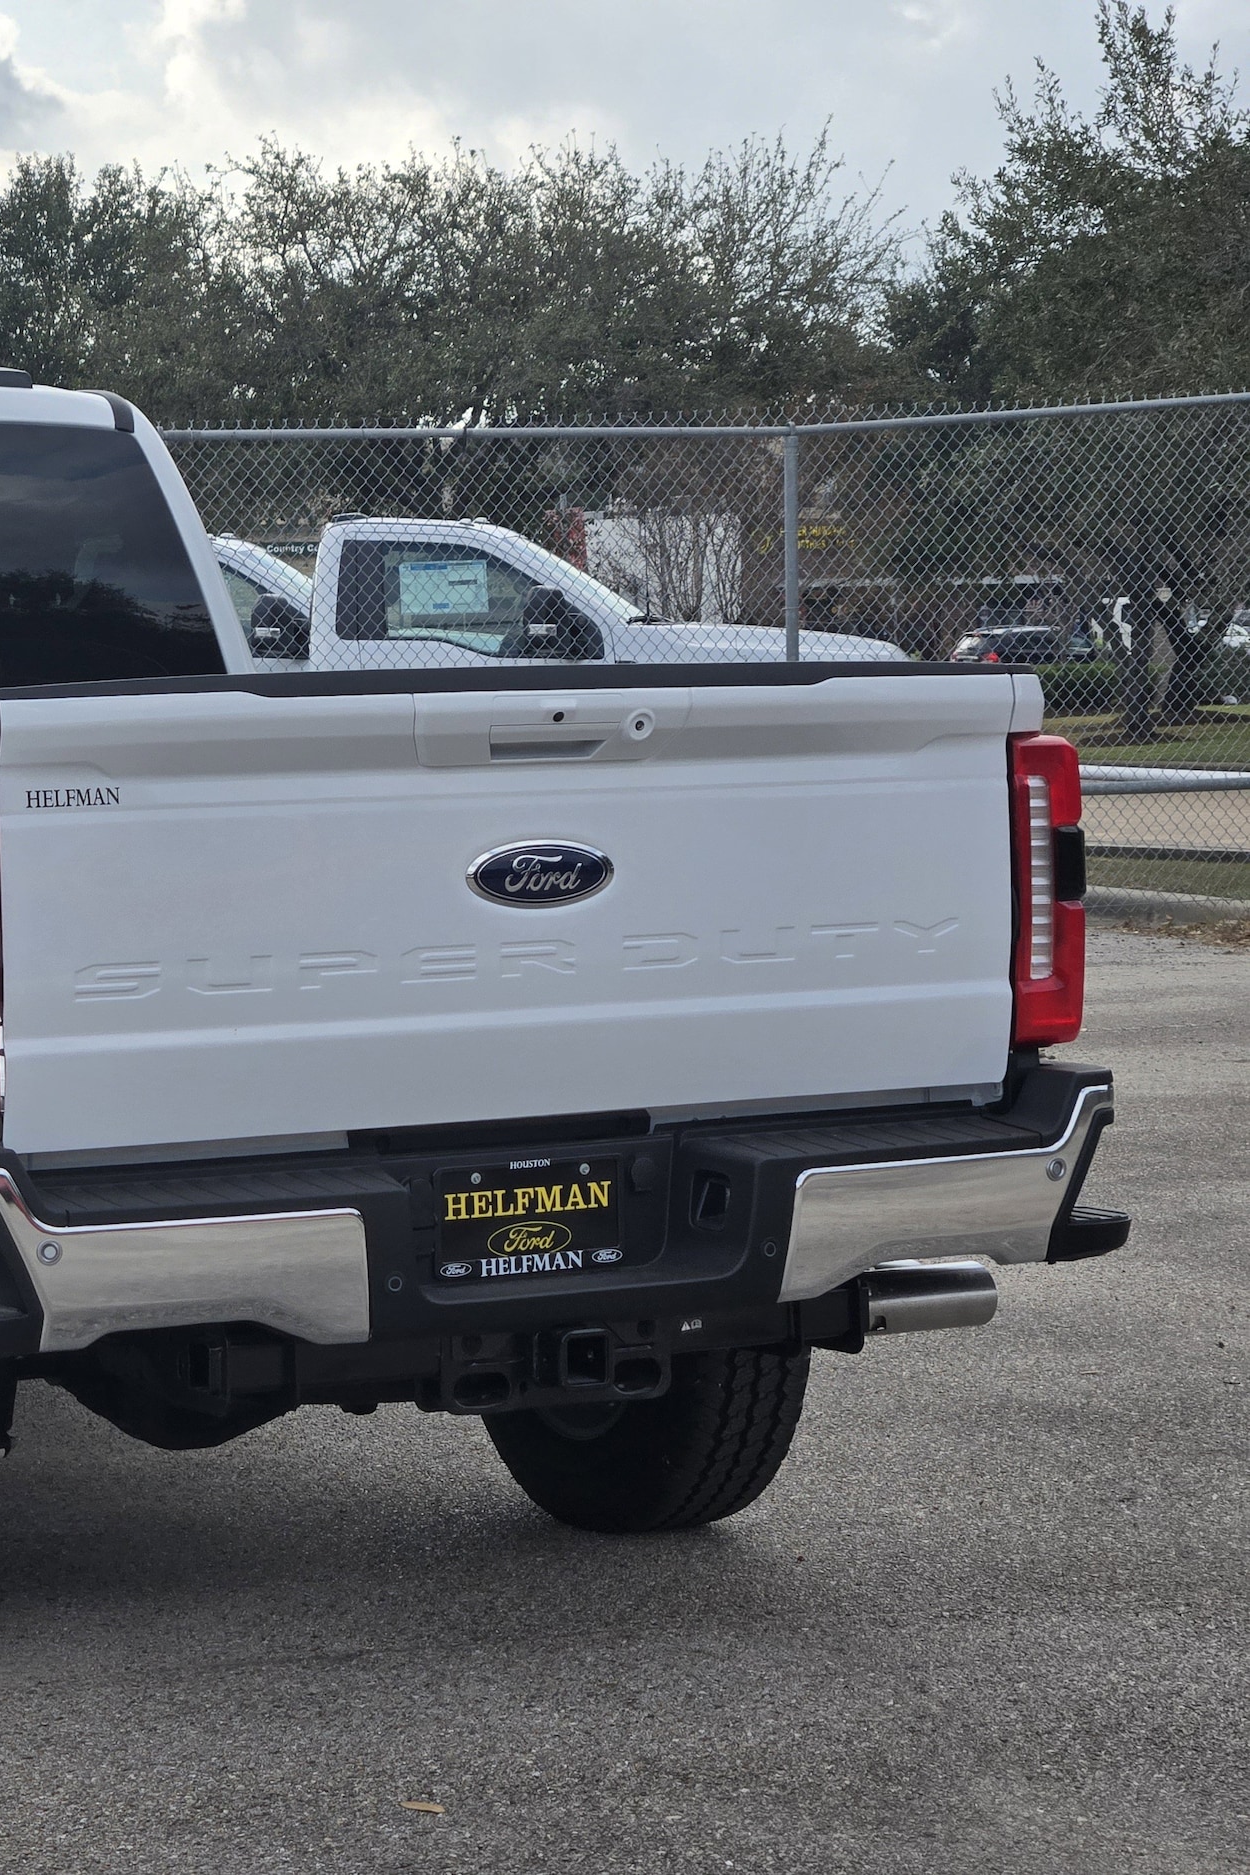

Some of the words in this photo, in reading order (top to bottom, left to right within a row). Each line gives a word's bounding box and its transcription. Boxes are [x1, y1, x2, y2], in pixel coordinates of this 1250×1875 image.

[266, 544, 305, 554] Country
[25, 787, 120, 808] HELFMAN
[504, 854, 583, 893] Ford
[74, 939, 577, 1002] SUPER
[622, 917, 959, 971] DUTY
[509, 1158, 552, 1170] HOUSTON
[444, 1181, 612, 1221] HELFMAN
[503, 1226, 556, 1253] Ford
[480, 1250, 584, 1278] HELFMAN
[596, 1251, 618, 1262] Ford
[444, 1264, 468, 1275] Ford
